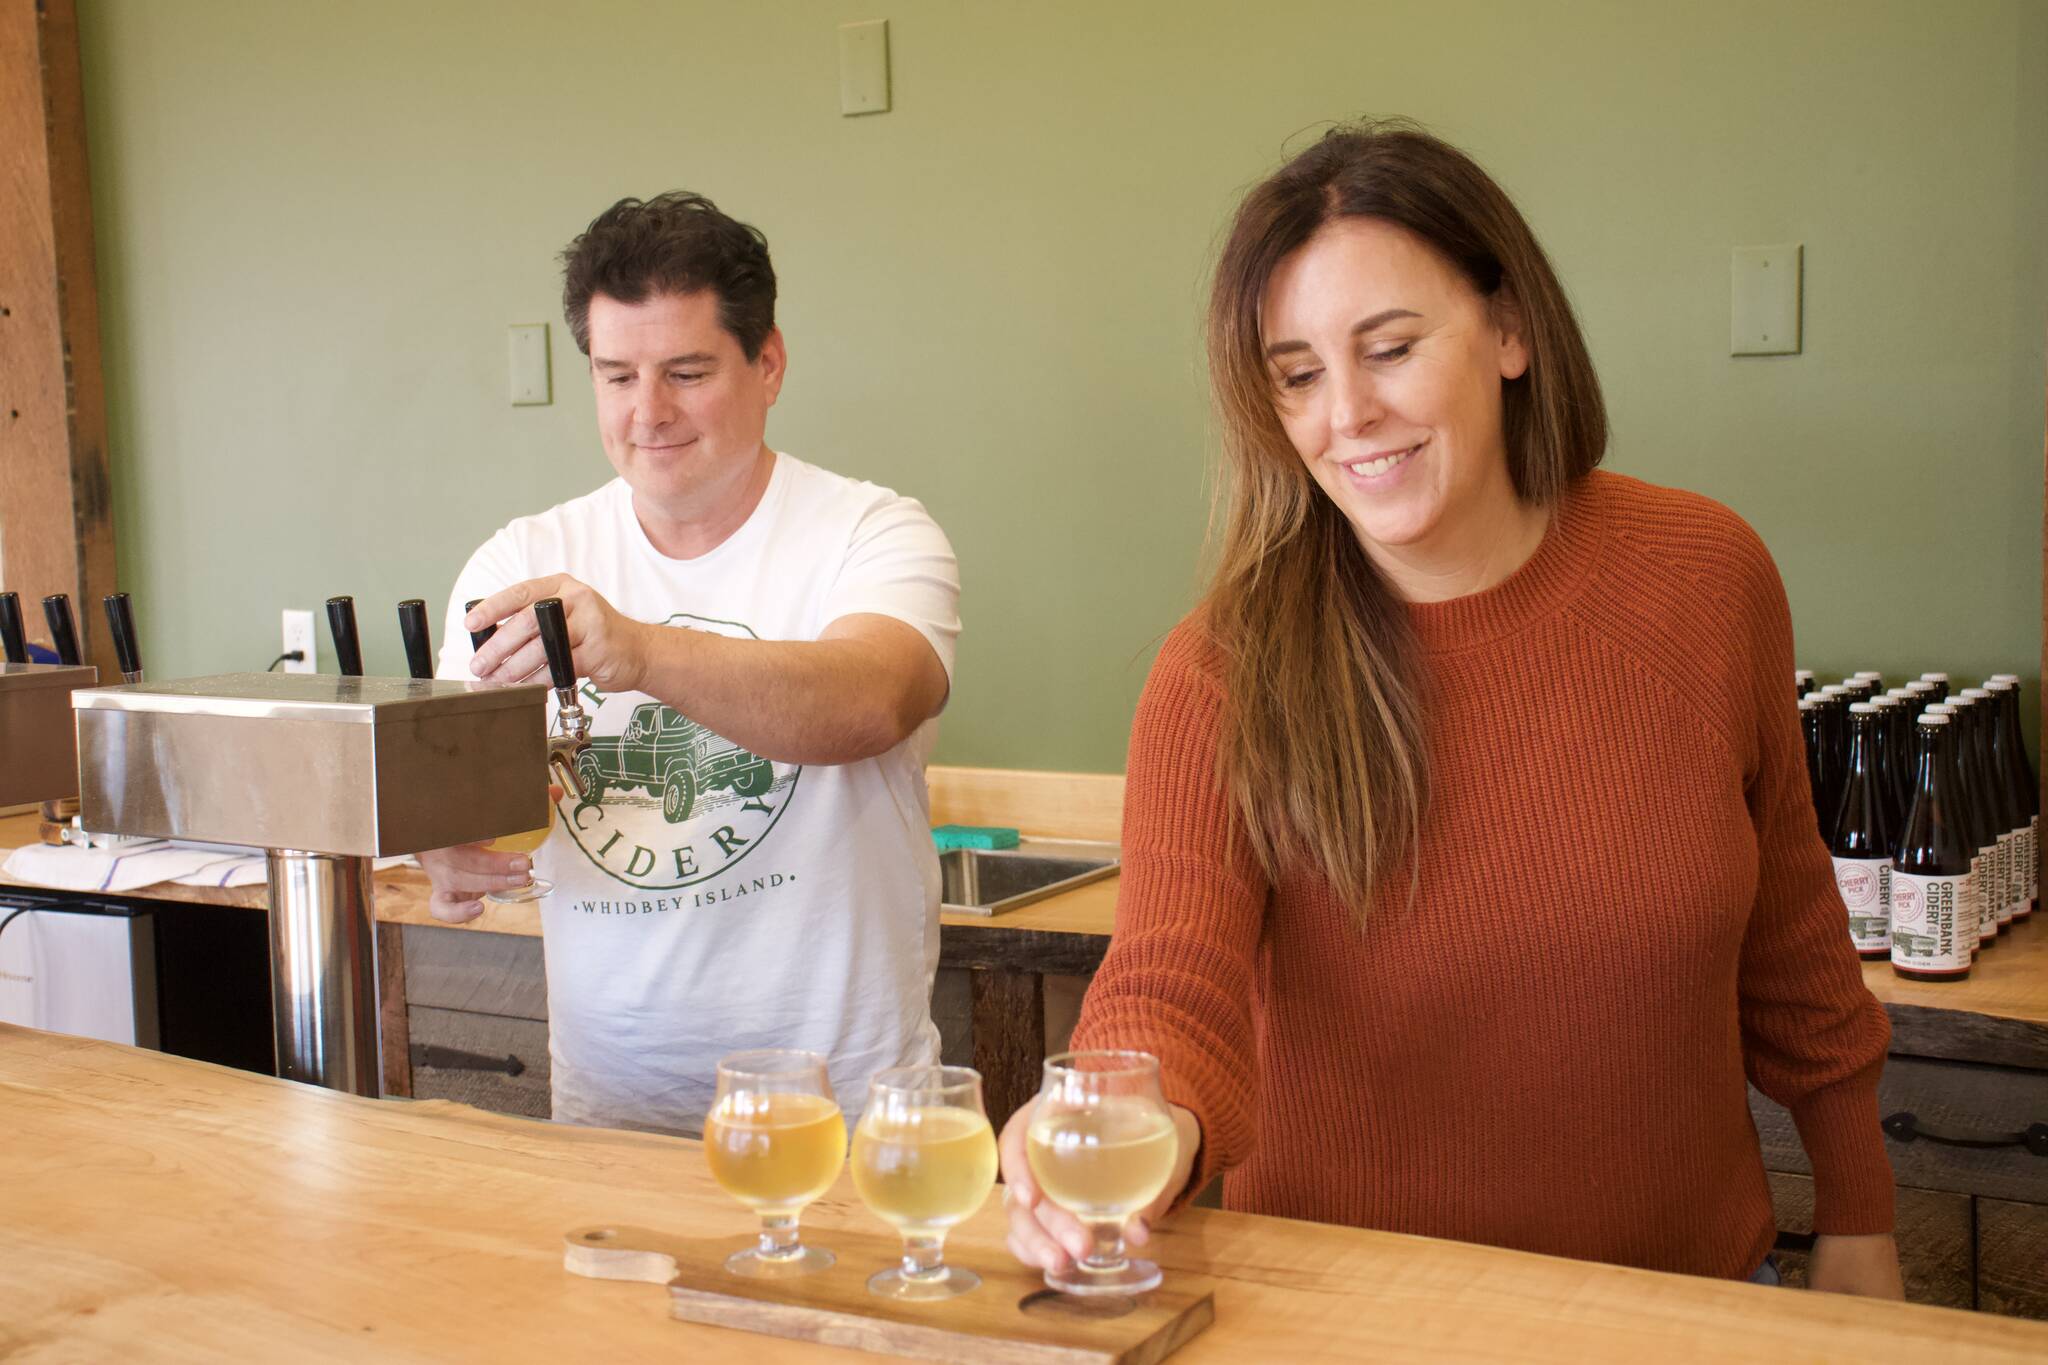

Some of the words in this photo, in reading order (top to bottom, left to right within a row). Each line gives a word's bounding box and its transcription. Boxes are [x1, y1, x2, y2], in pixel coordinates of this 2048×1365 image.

[573, 796, 776, 880] CIDERY
[2014, 833, 2023, 873] CIDERY
[1978, 852, 1988, 894] CIDERY
[1996, 839, 2005, 880] CIDERY
[582, 896, 683, 915] WHIDBEY
[694, 873, 784, 908] ISLAND
[1839, 877, 1869, 888] CHERRY
[1879, 864, 1890, 906] CIDERY
[1987, 850, 1996, 921] GREENBANK
[1926, 882, 1940, 926] CIDERY
[1940, 881, 1953, 956] GREENBANK
